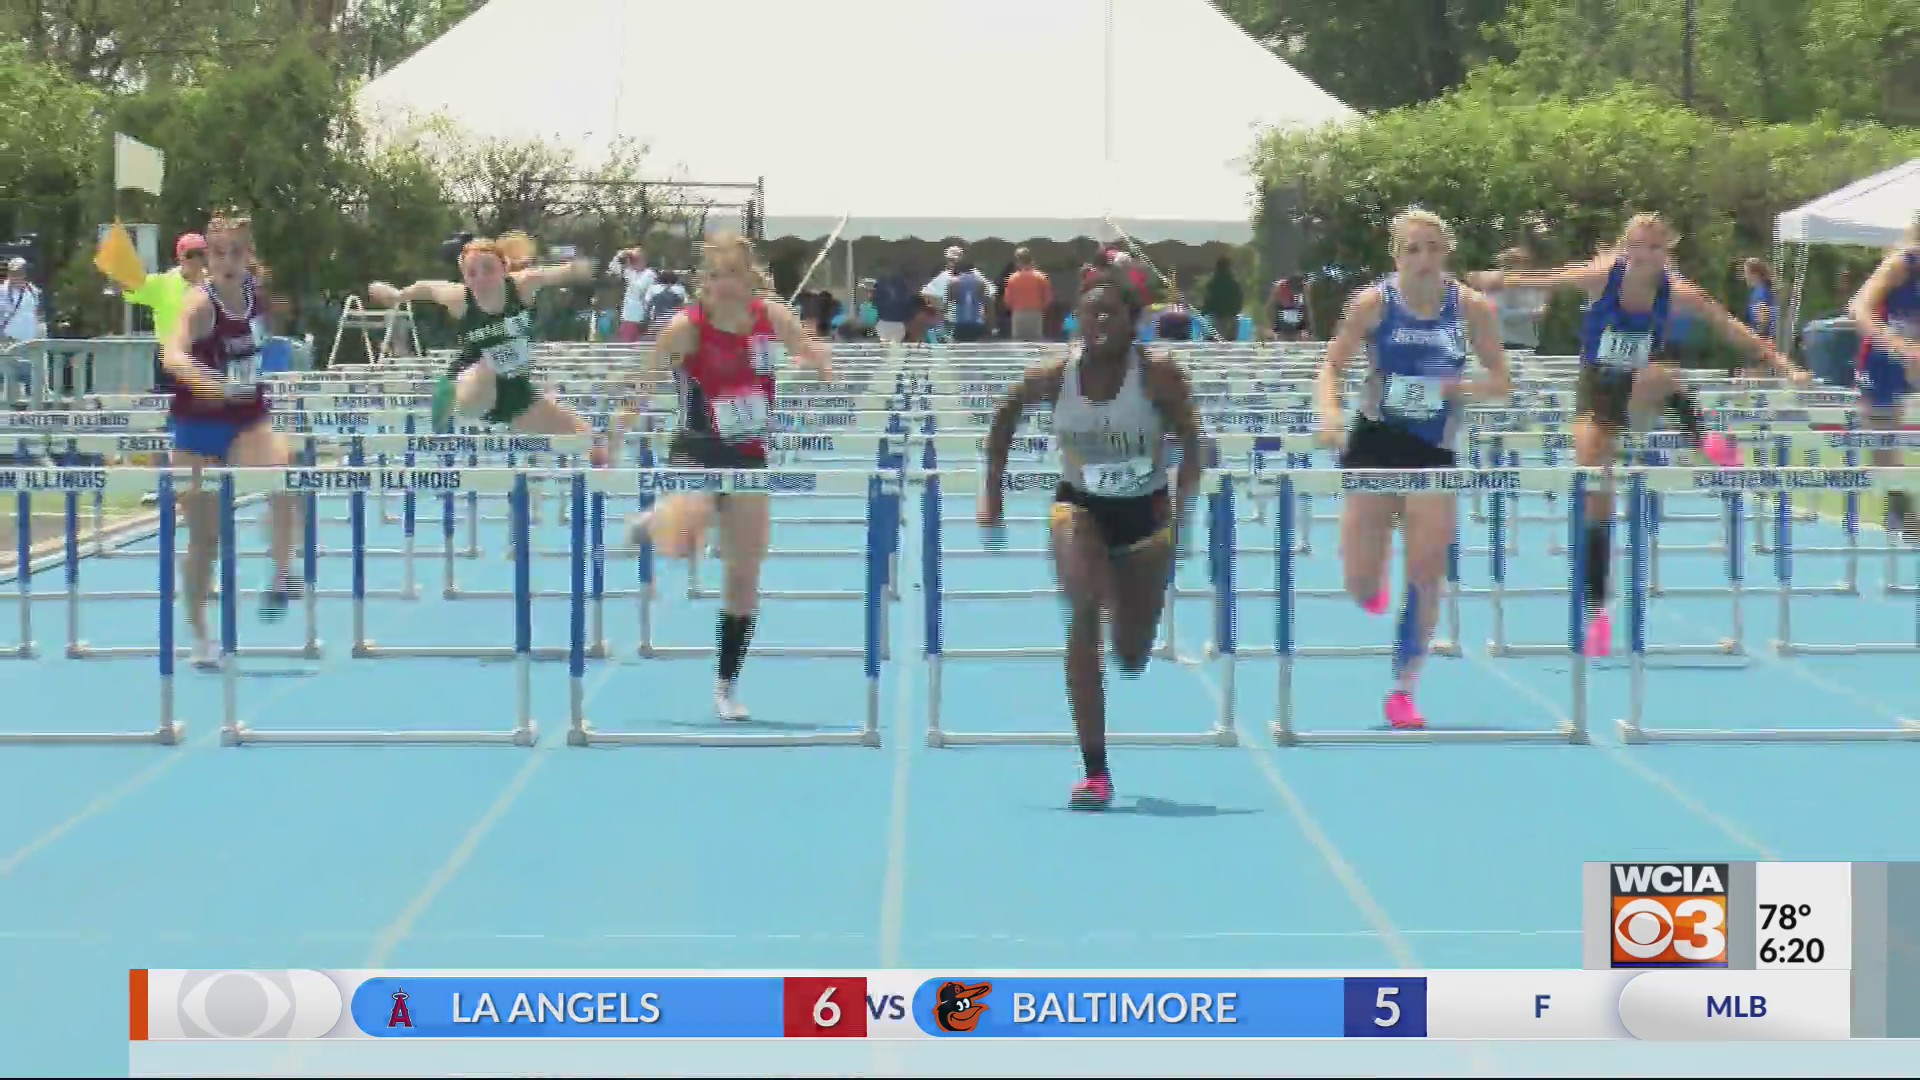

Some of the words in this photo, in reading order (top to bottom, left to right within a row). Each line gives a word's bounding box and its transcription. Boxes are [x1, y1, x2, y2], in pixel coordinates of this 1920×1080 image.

[117, 436, 172, 451] EASTE
[25, 470, 106, 489] ILLINOIS
[286, 470, 371, 489] EASTERN
[380, 470, 461, 489] ILLINOIS
[1002, 472, 1063, 491] ASTER
